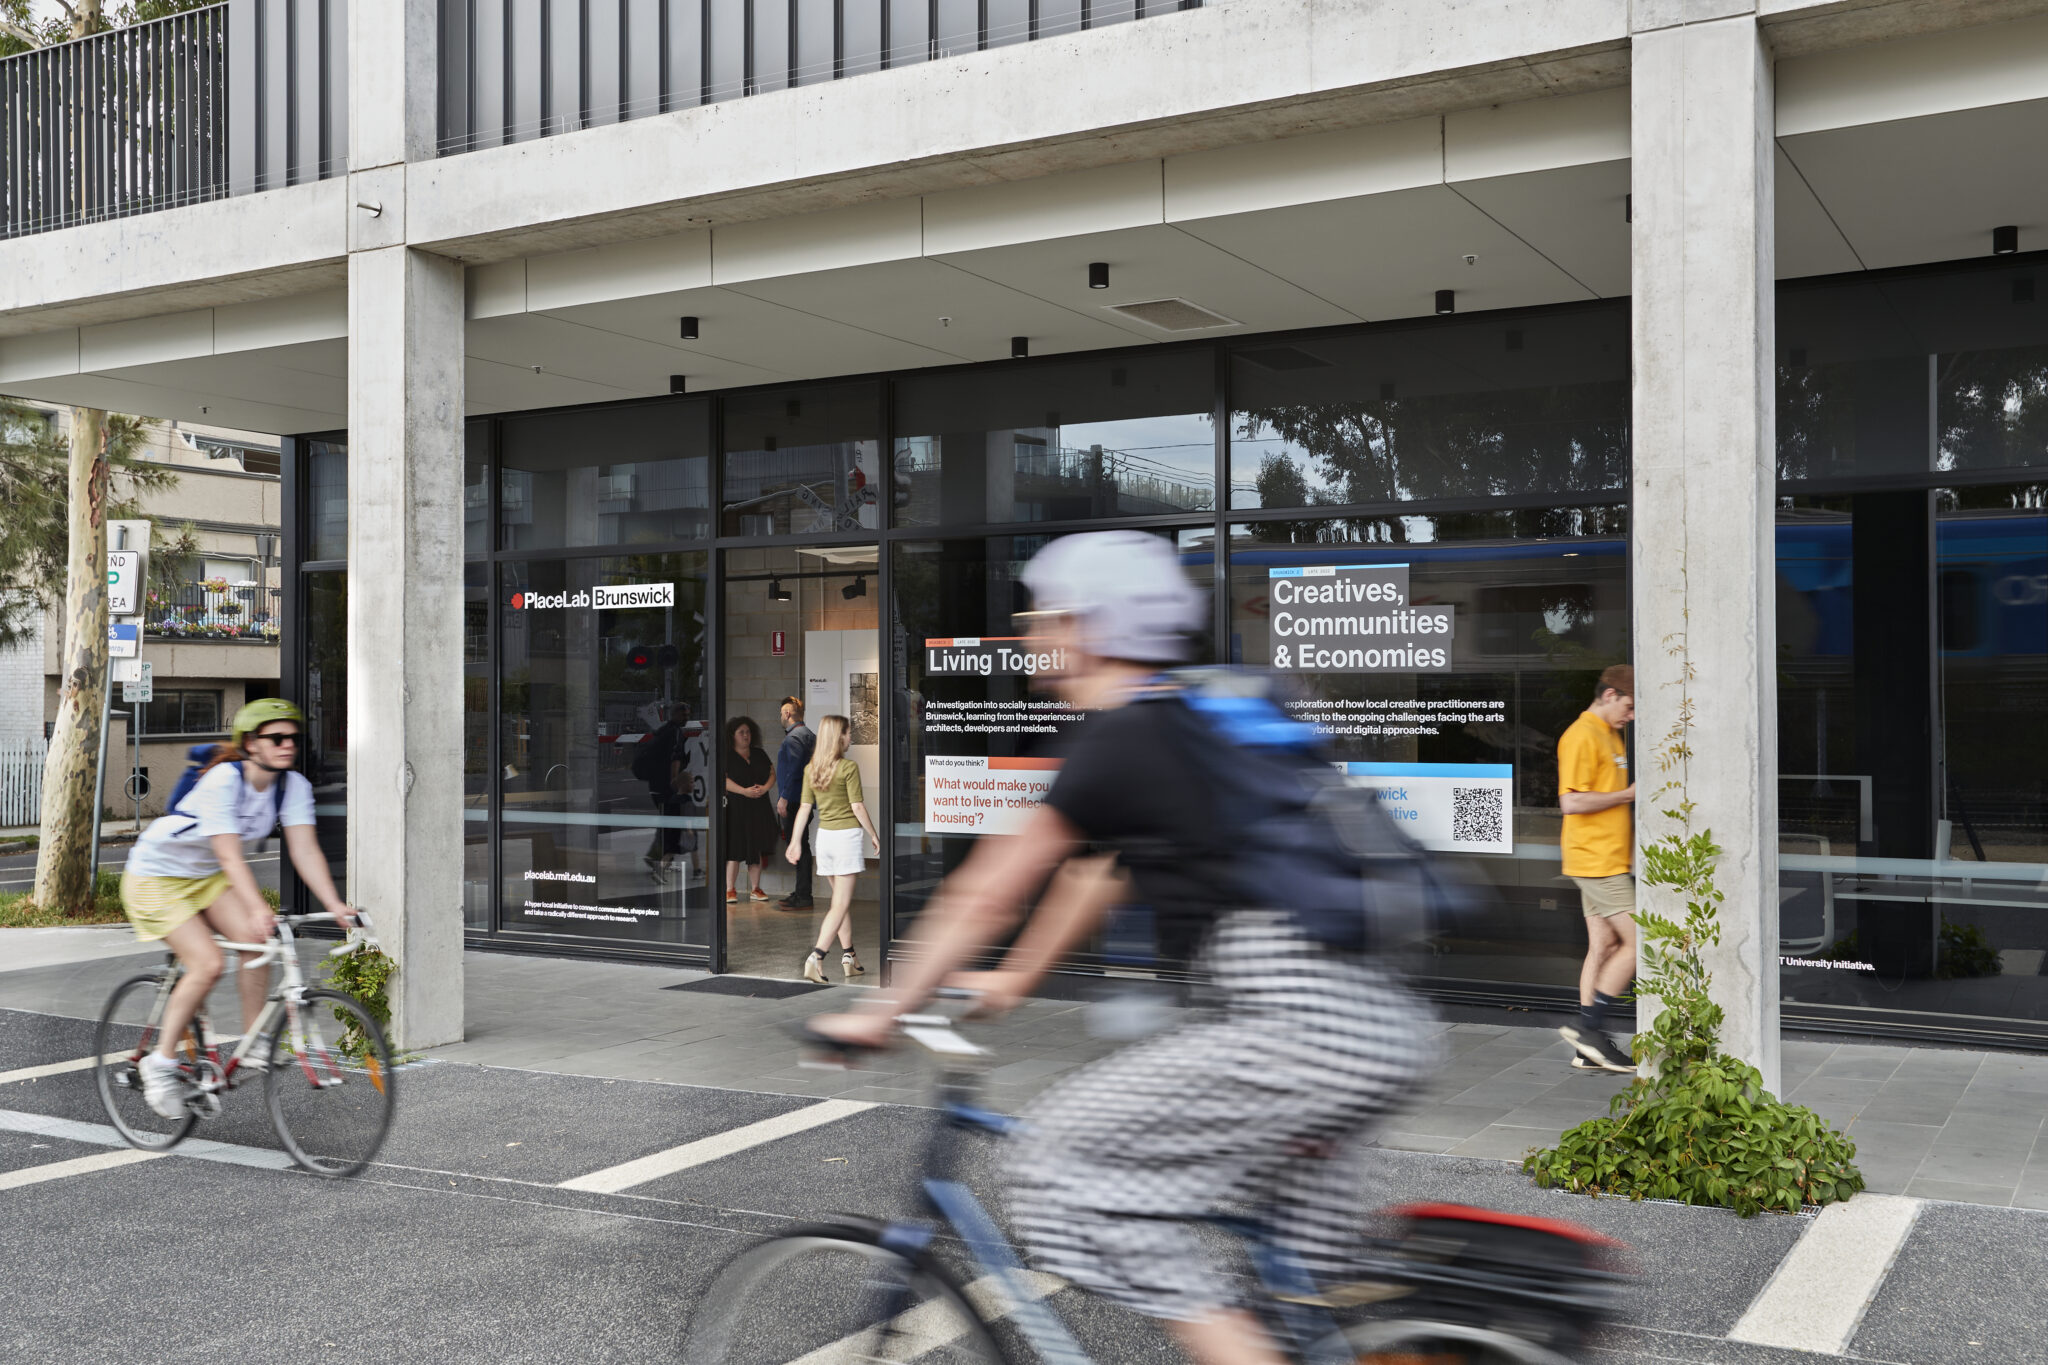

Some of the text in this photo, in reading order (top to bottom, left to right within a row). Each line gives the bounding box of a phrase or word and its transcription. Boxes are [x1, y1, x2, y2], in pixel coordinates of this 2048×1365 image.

[108, 555, 126, 568] ND
[1274, 578, 1404, 605] Creatives,
[524, 587, 671, 609] PlaceLab Brunswick
[1274, 609, 1449, 636] Communities
[930, 648, 1066, 675] Living Togeth
[1274, 643, 1446, 669] & Economies
[926, 701, 936, 709] An
[937, 701, 982, 711] investigation
[984, 701, 998, 709] into
[999, 701, 1027, 711] socially
[1028, 701, 1072, 710] sustainable
[1334, 700, 1344, 709] of
[1345, 700, 1365, 709] how
[1366, 700, 1388, 709] local
[1389, 700, 1426, 709] creative
[1427, 700, 1488, 711] practitioners
[926, 712, 1085, 723] Brunswick, learning from the experiences of
[1290, 712, 1505, 724] onding to the ongoing challenges facing the arts
[926, 724, 1058, 735] architects, developers and residents.
[1312, 725, 1439, 736] ybrid and digital approaches.
[965, 759, 985, 767] think?
[933, 778, 1049, 794] What would make you
[933, 796, 959, 807] want
[961, 796, 972, 808] to
[973, 796, 991, 808] live
[993, 797, 1003, 808] in
[524, 870, 596, 883] placelab.rmit.edu.au
[548, 910, 567, 918] radically
[1786, 958, 1832, 969] University
[1833, 960, 1875, 970] initiative.
